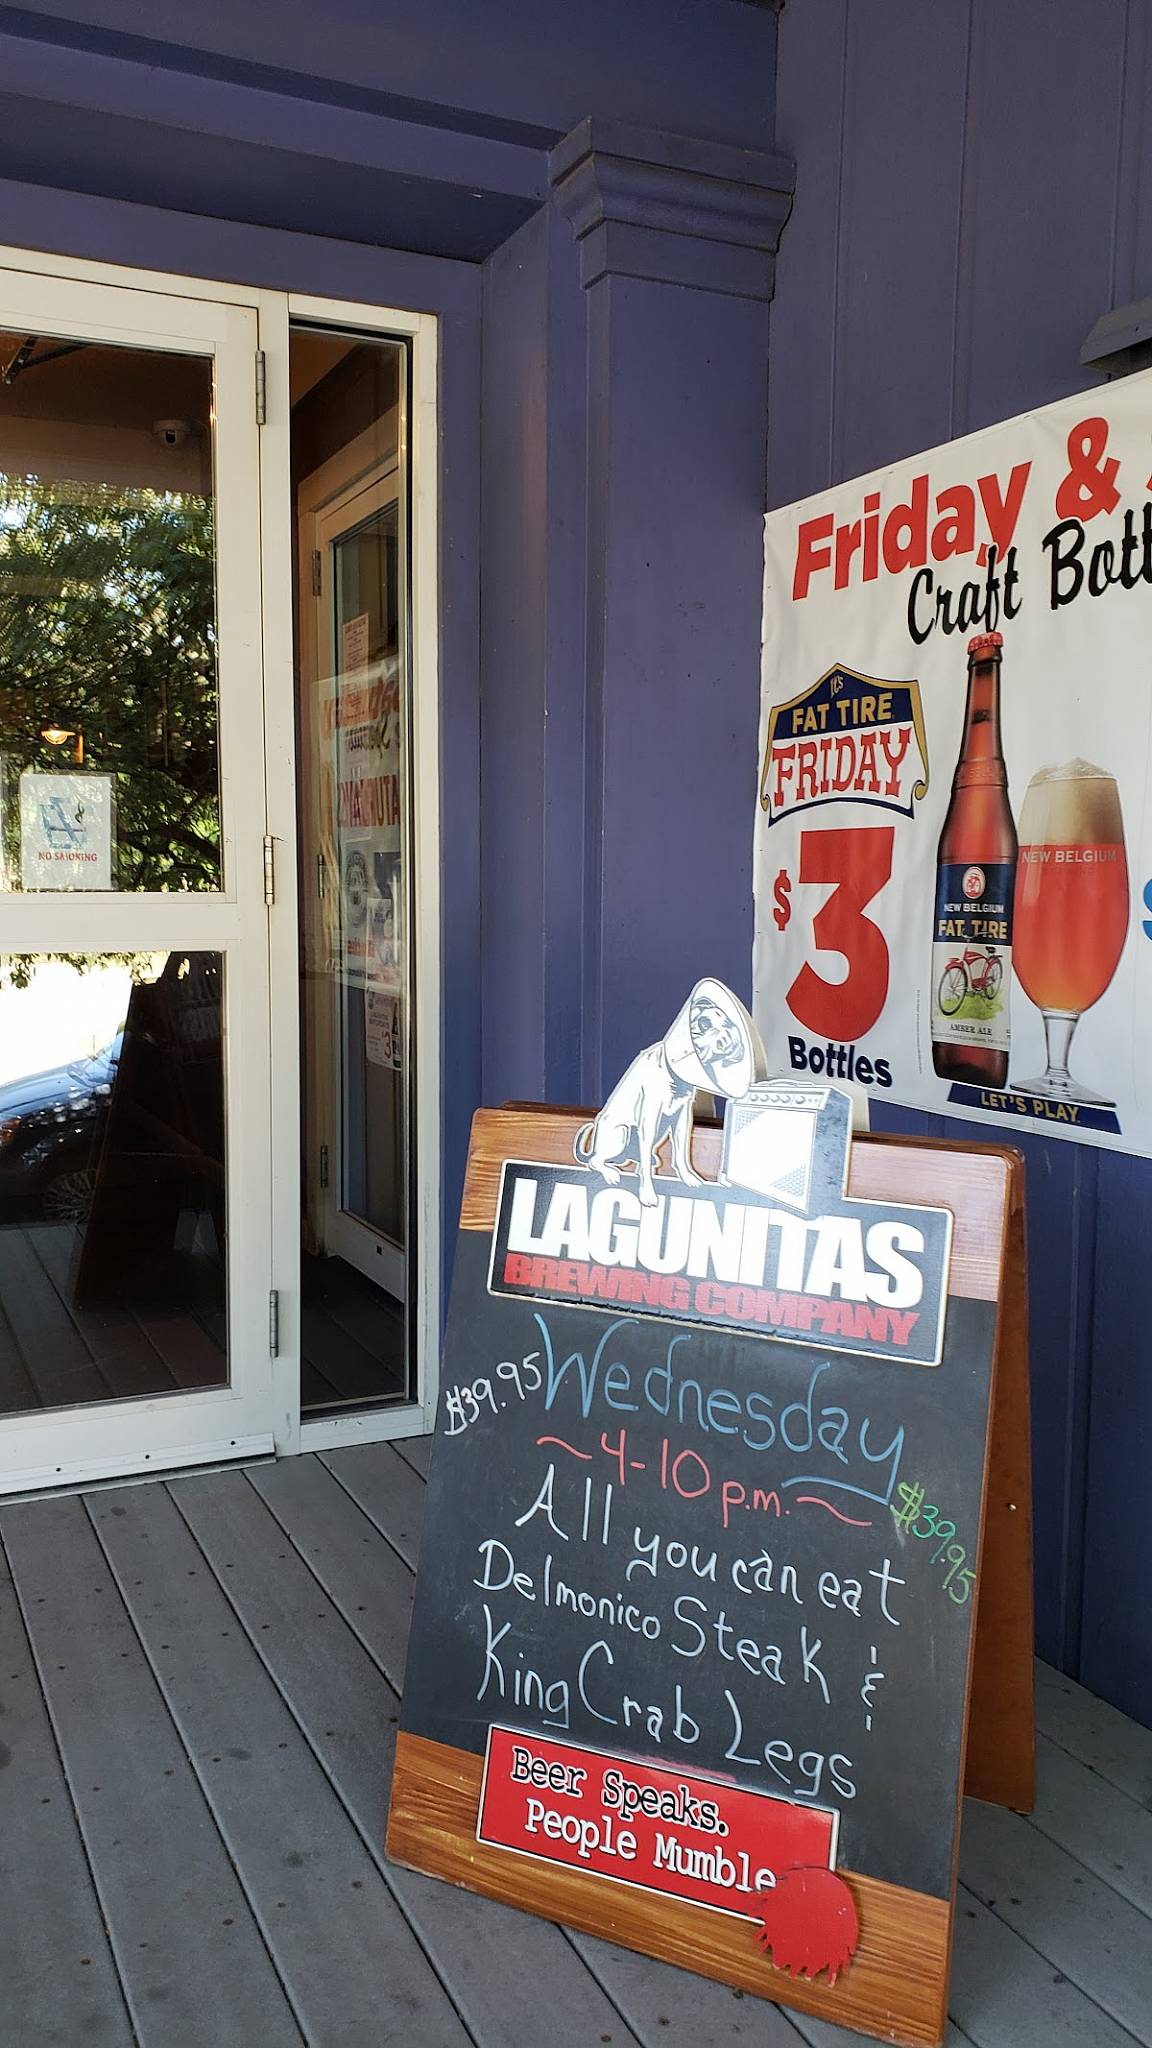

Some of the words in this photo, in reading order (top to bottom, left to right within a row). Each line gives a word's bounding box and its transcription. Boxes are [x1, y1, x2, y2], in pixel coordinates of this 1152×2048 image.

[792, 460, 1033, 601] Friday
[1055, 416, 1121, 522] &
[907, 543, 1023, 645] Craft
[792, 703, 830, 734] FAT
[836, 692, 893, 727] TIRE
[772, 726, 912, 808] FRIDAY
[1021, 850, 1051, 864] NEW
[1055, 850, 1117, 864] BELGIUM
[938, 919, 965, 937] FAT
[970, 919, 1008, 940] TIRE
[943, 903, 962, 913] NEW
[963, 903, 1005, 914] BELGIUM
[787, 1035, 893, 1089] Bottles
[980, 1090, 1028, 1114] LET'S
[507, 1178, 926, 1309] LAGUNITAS
[503, 1252, 691, 1314] BREWING
[694, 1281, 921, 1346] COMPANY
[443, 1350, 542, 1437] $39.95
[534, 1312, 905, 1507] Wednesday
[600, 1429, 711, 1500] 4-10
[473, 1538, 661, 1641] Delmonico
[514, 1463, 613, 1545] All
[626, 1526, 717, 1582] you
[731, 1549, 804, 1604] can
[817, 1558, 906, 1626] eat
[889, 1481, 977, 1605] $39.95
[476, 1603, 570, 1728] King
[577, 1640, 701, 1745] Crab
[723, 1688, 857, 1800] Legs
[510, 1744, 587, 1797] Beer
[600, 1769, 731, 1838] Speaks.
[524, 1797, 638, 1861] People
[652, 1832, 777, 1895] Mumble
